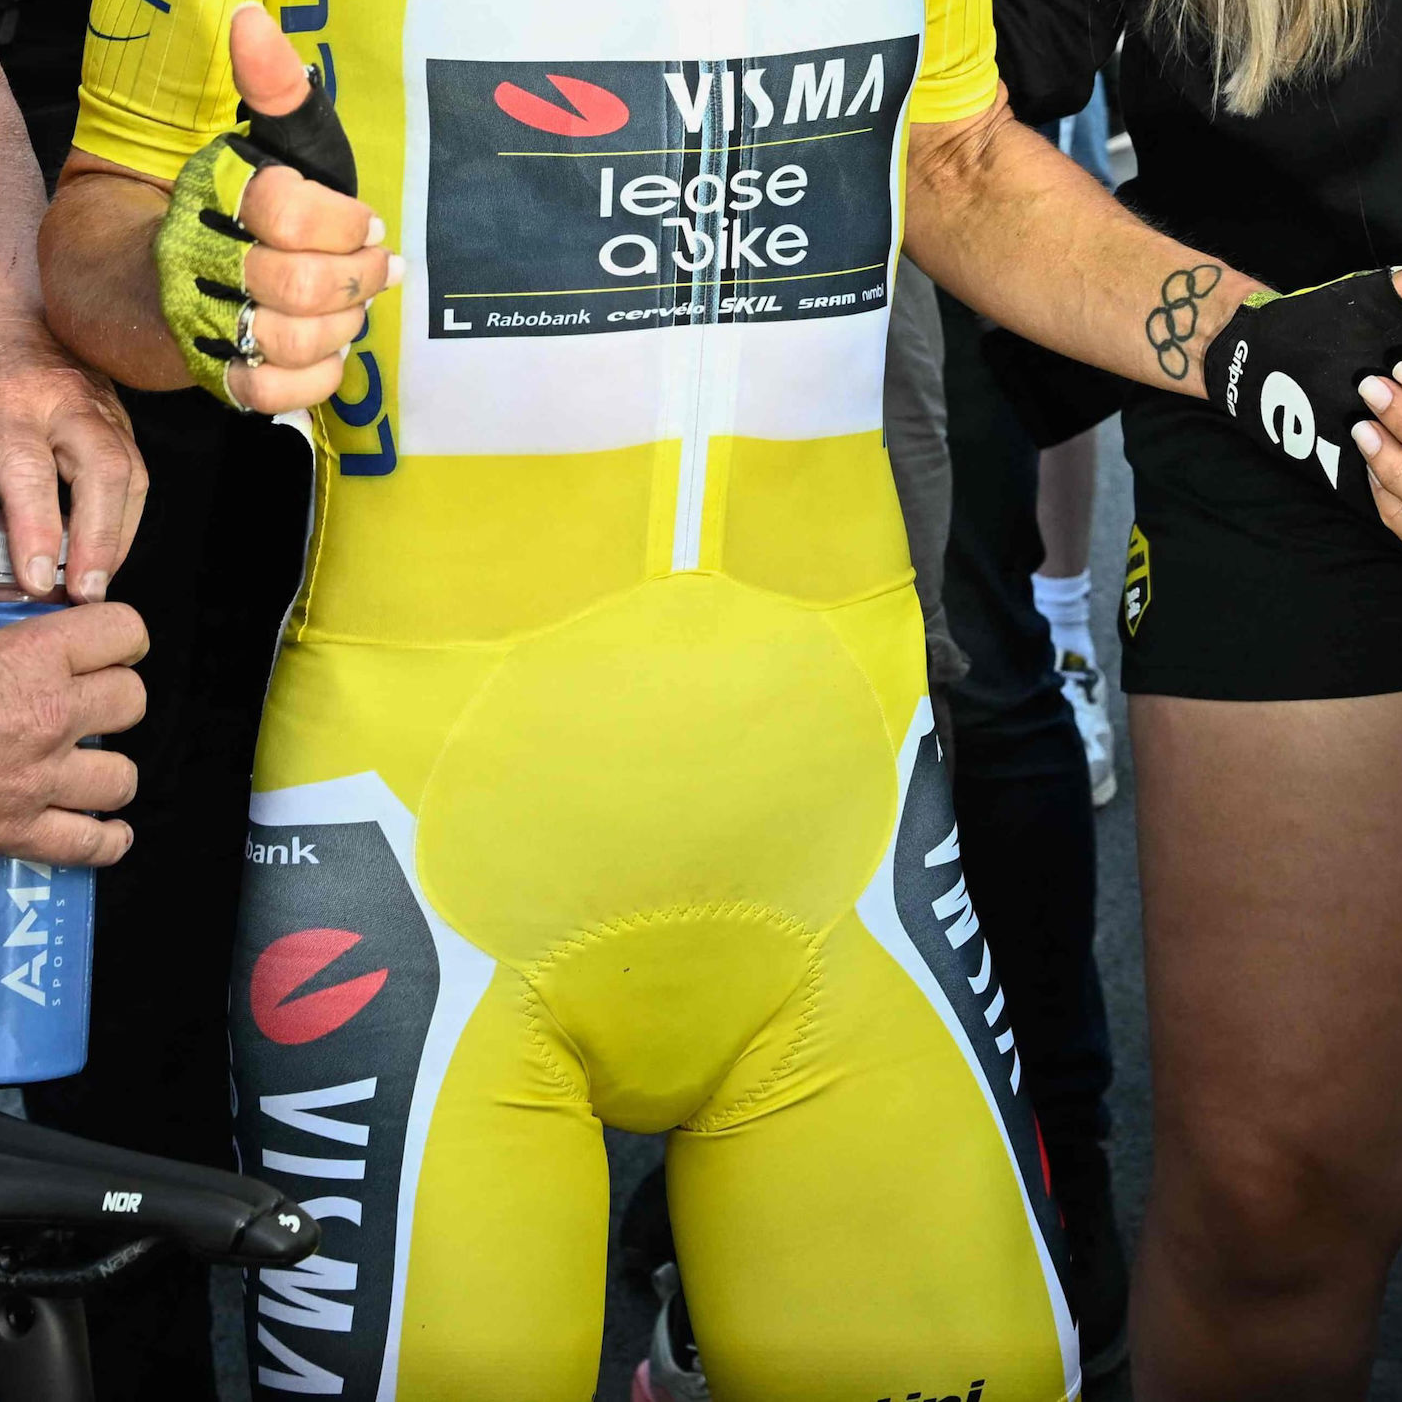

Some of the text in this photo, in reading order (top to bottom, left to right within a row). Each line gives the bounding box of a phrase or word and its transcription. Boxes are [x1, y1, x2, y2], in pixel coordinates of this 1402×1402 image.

[664, 53, 885, 134] VISMA
[600, 164, 808, 218] lease
[486, 309, 591, 327] Rabobank
[718, 295, 783, 315] SKIL
[798, 292, 856, 310] SRAM
[1226, 340, 1248, 417] GripGr
[52, 898, 66, 1007] SPORTS
